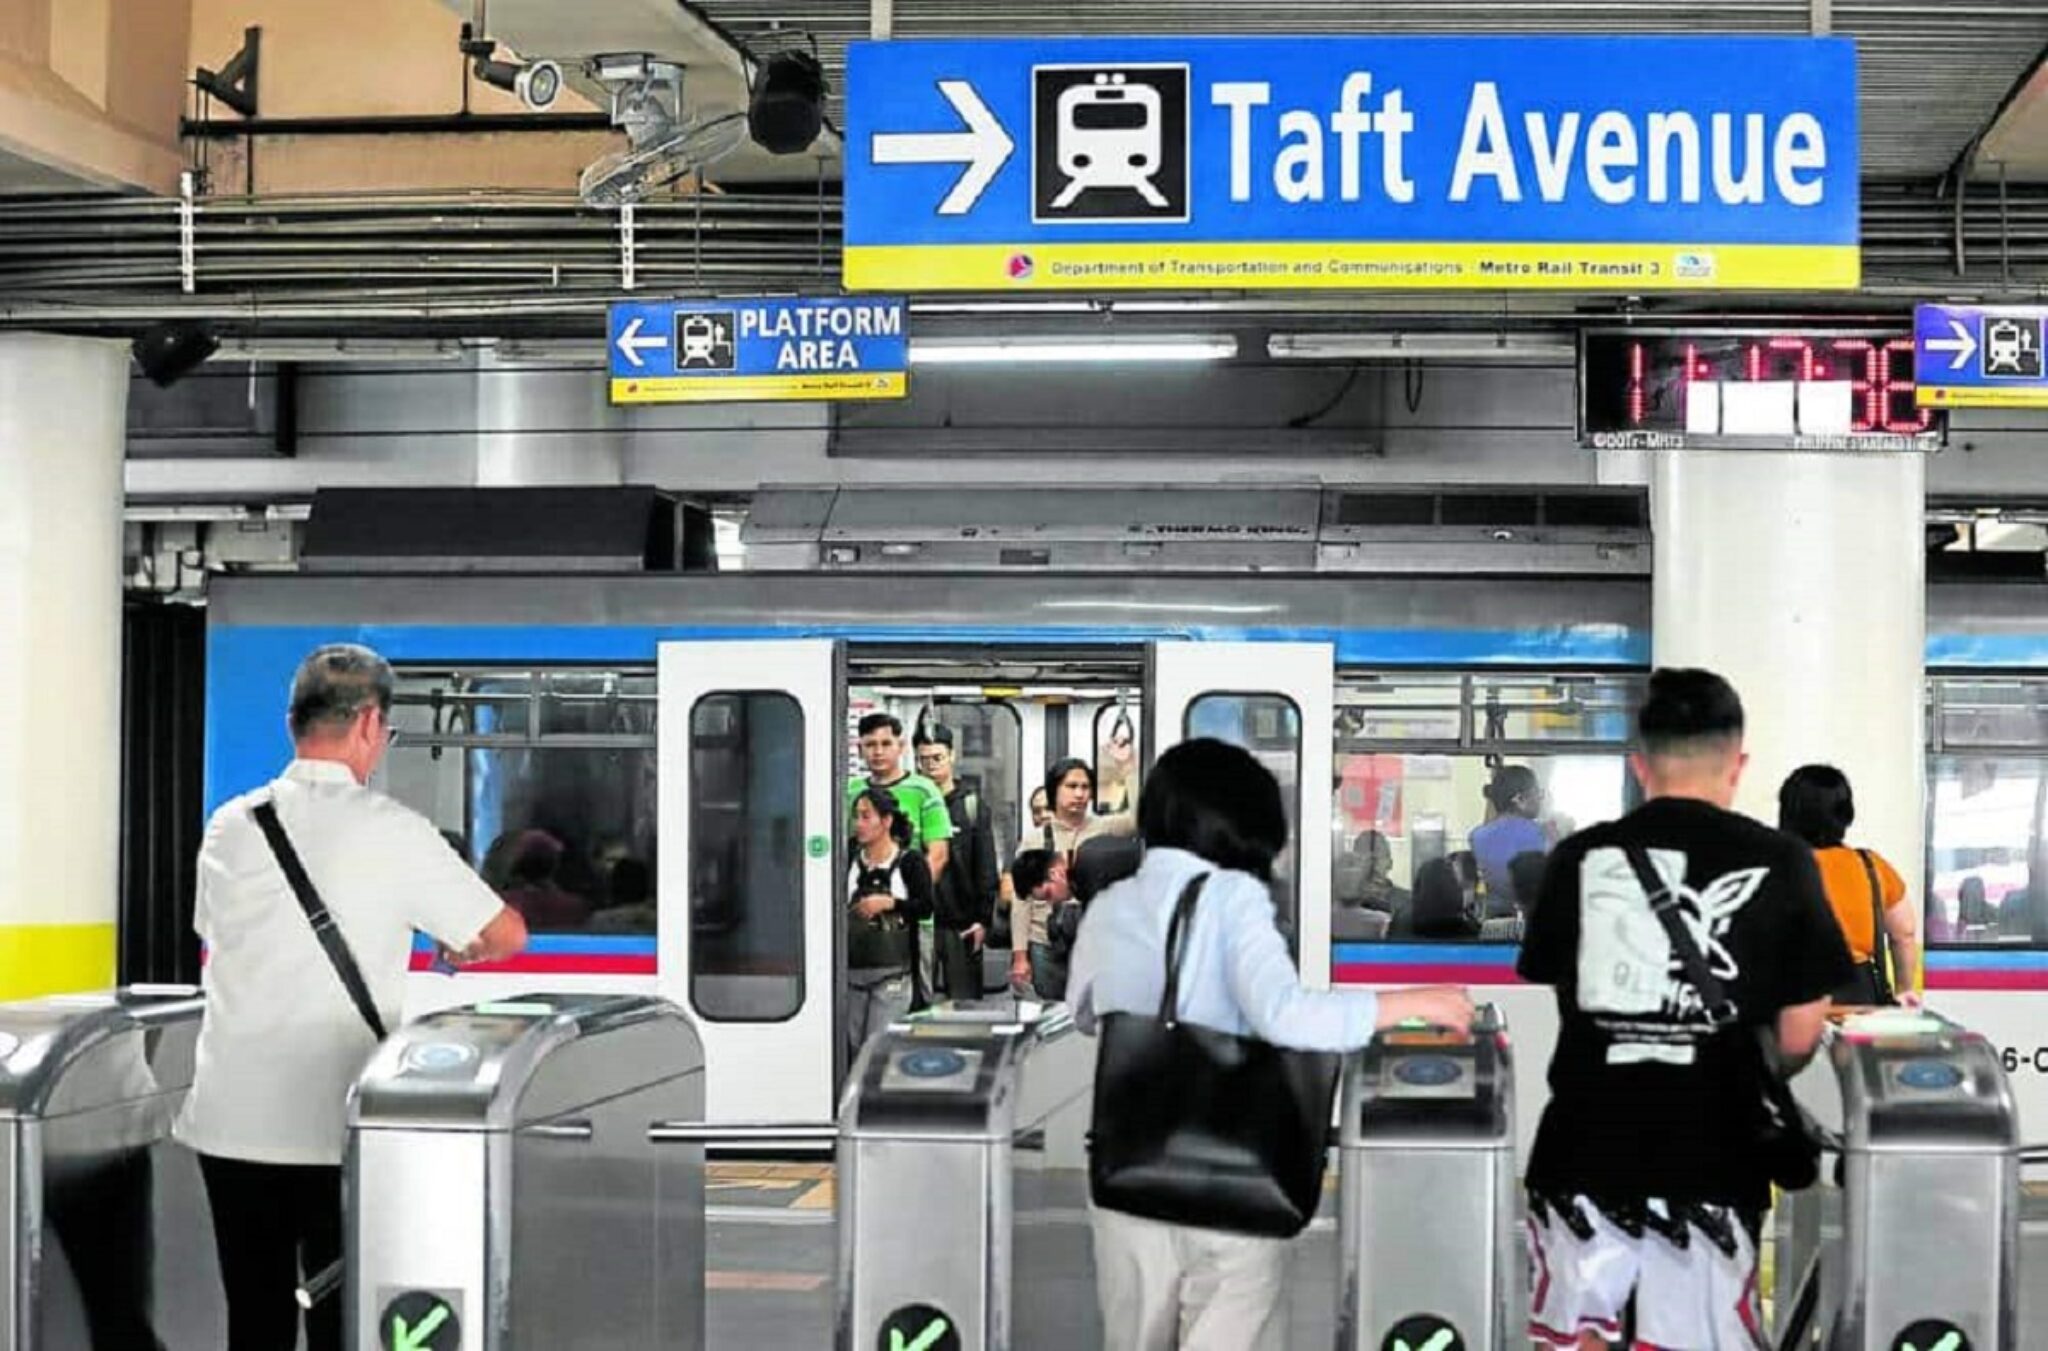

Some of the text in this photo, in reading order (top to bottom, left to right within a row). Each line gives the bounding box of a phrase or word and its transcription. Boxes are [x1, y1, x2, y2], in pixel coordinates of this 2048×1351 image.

[1211, 71, 1827, 205] Taft Avenue
[1052, 261, 1144, 276] Department
[1147, 261, 1165, 274] of
[1170, 260, 1289, 276] Transportation
[1293, 261, 1322, 274] and
[1480, 261, 1531, 275] Metro
[1537, 261, 1572, 275] Rail
[1578, 261, 1643, 275] Transit
[740, 305, 901, 338] PLATFORM
[776, 340, 859, 370] AREA
